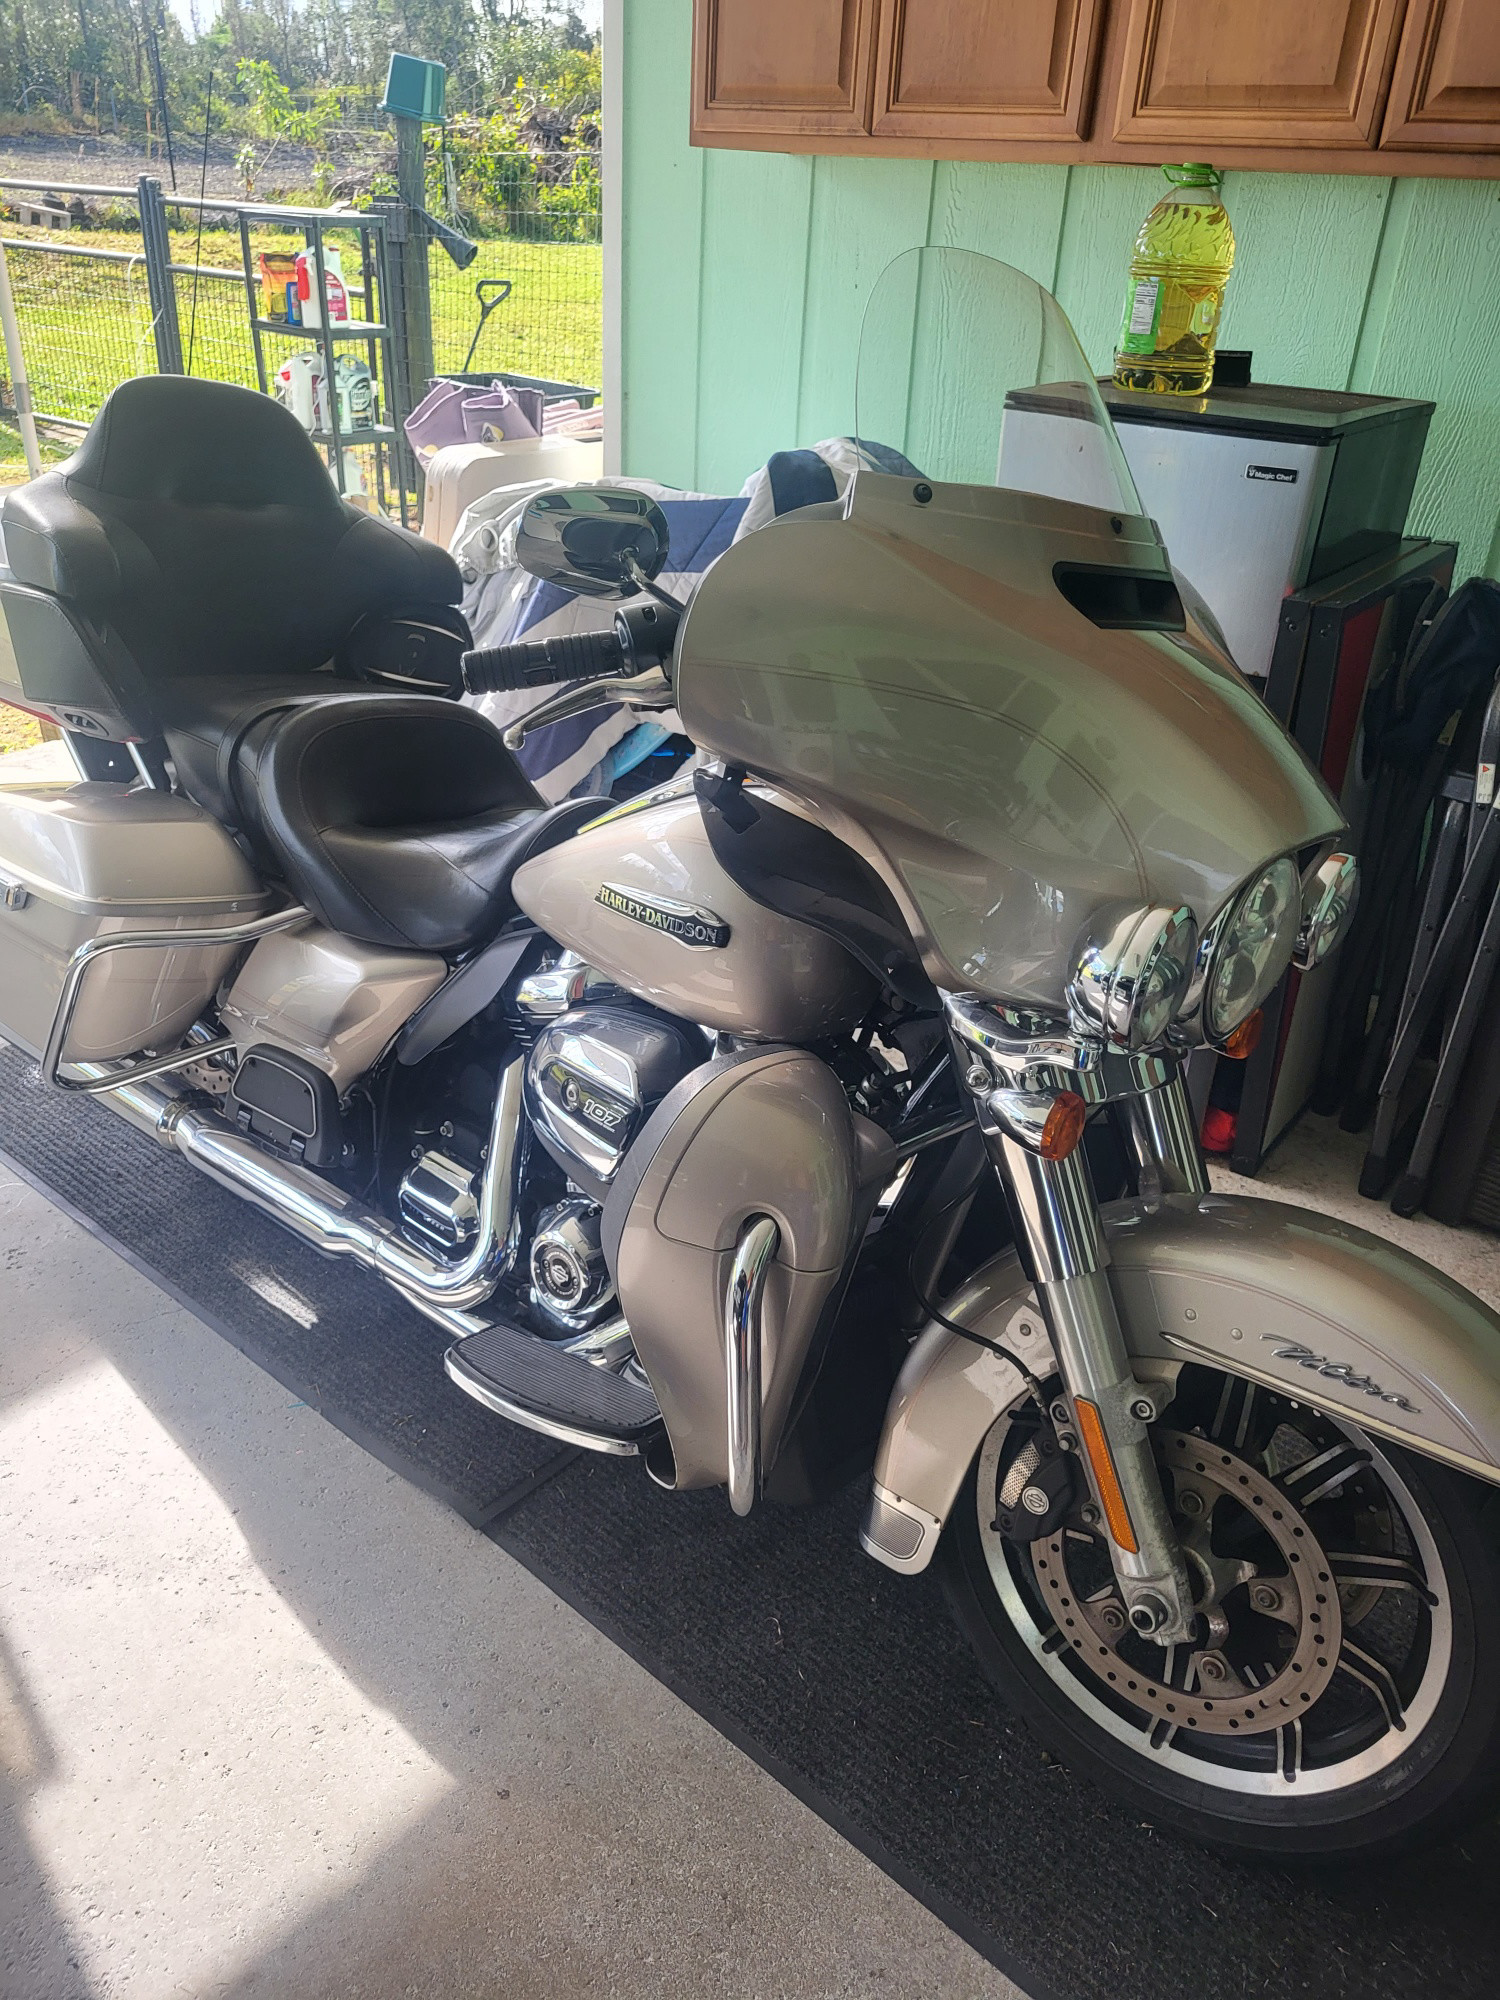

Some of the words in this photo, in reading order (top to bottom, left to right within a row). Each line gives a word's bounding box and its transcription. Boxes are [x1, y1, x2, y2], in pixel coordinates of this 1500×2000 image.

[1254, 471, 1275, 480] Magic
[1276, 473, 1293, 481] Chef
[600, 886, 718, 943] HARLEY-DAVIDSON
[583, 1099, 621, 1127] 107
